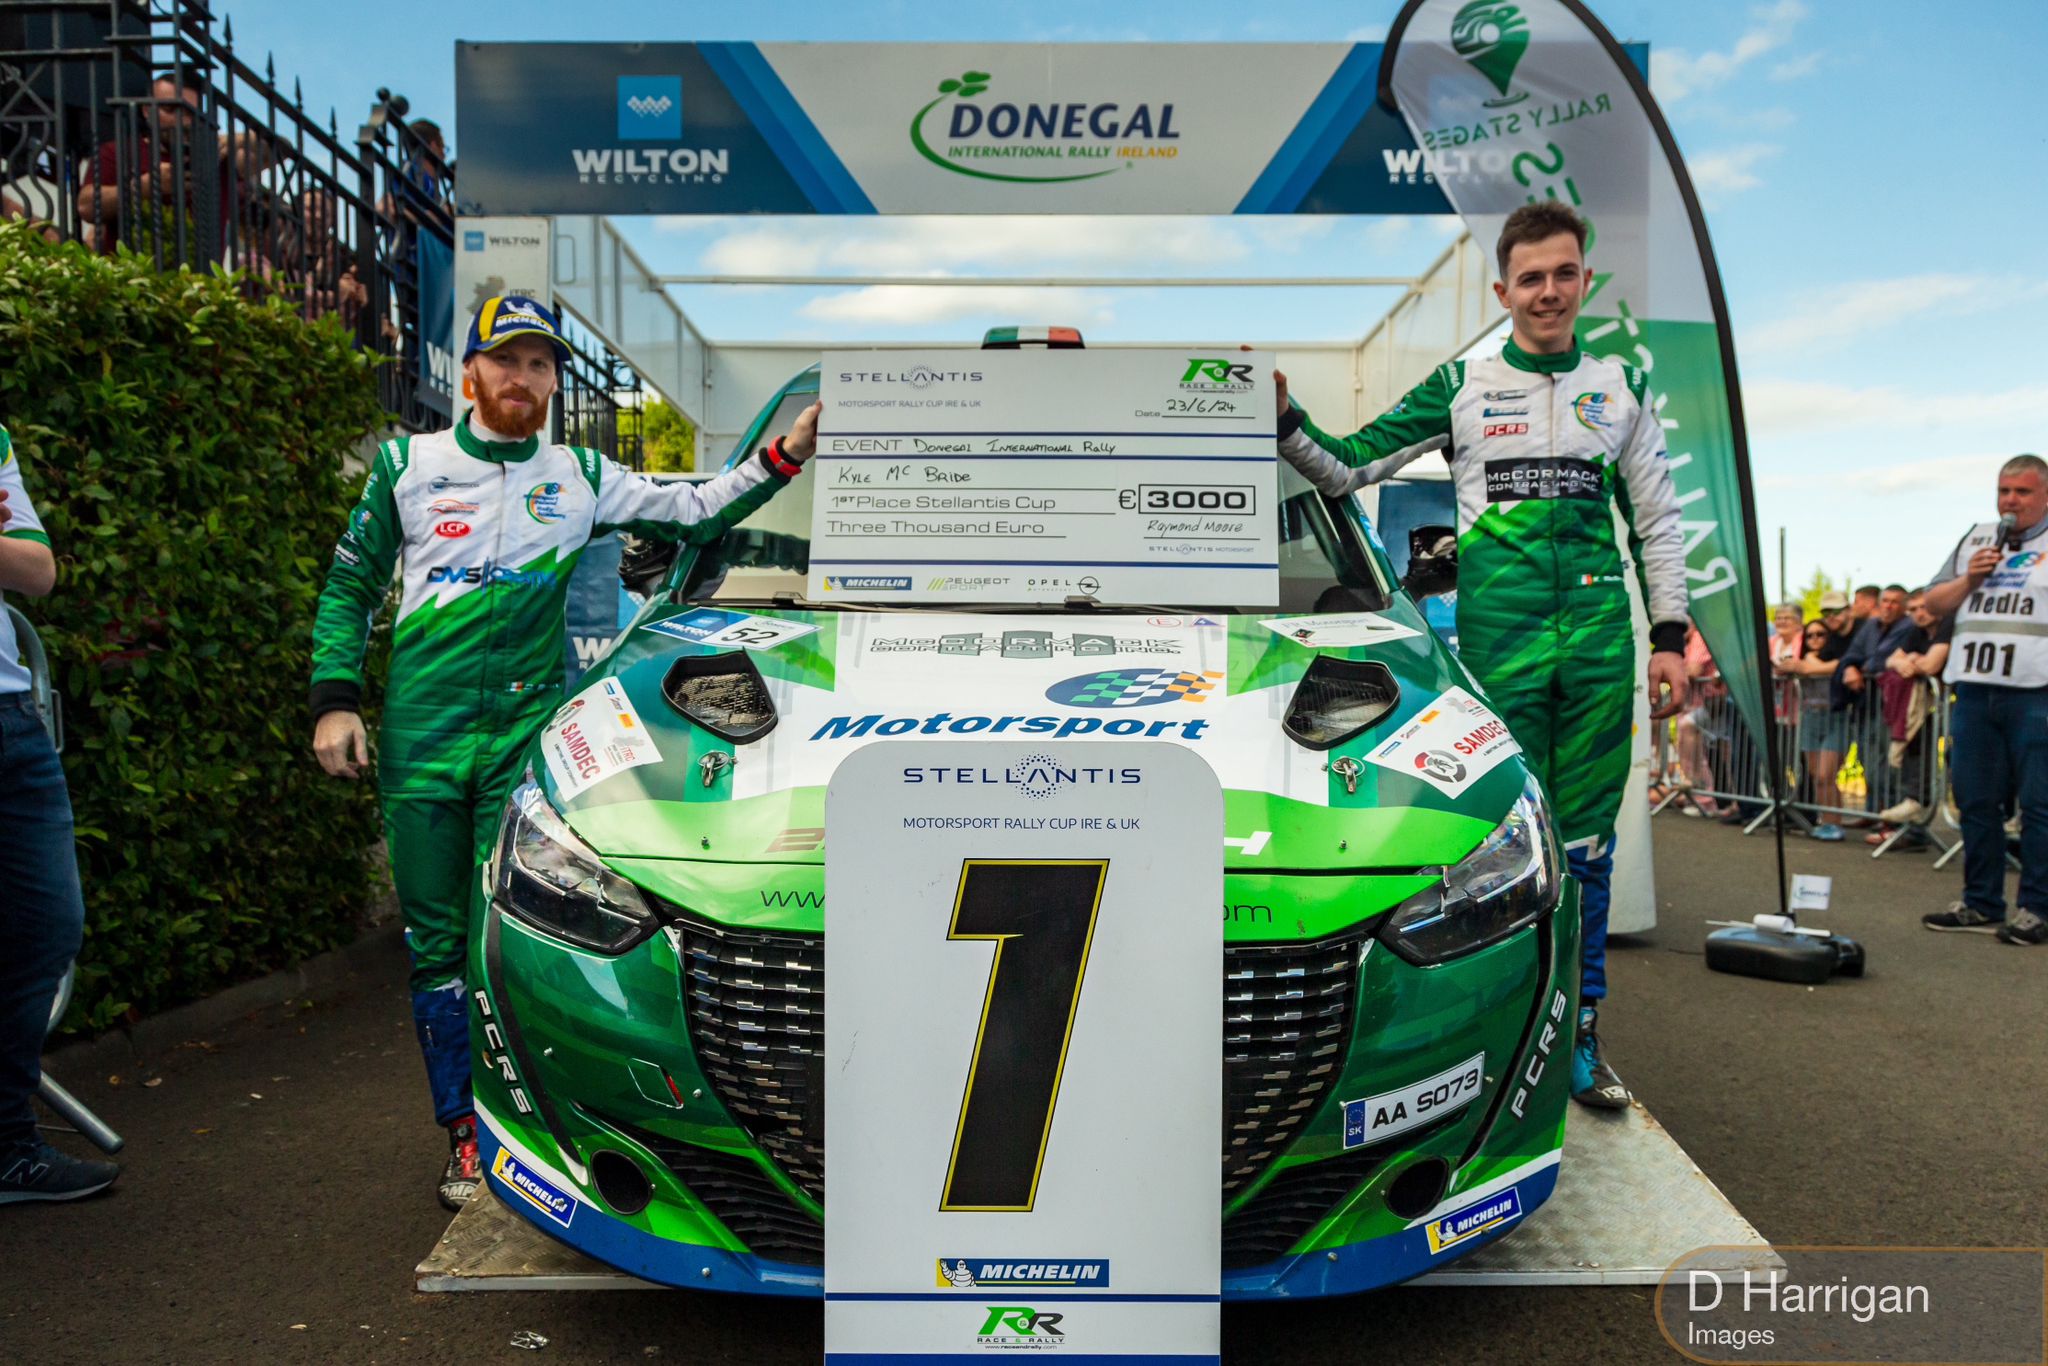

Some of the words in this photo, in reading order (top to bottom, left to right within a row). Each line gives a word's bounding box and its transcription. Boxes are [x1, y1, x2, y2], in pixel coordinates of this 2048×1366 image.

[948, 103, 1181, 139] DONEGAL
[948, 145, 1063, 159] INTERNATIONAL
[1067, 145, 1112, 159] RALLY
[1115, 146, 1179, 159] IRELAND
[572, 148, 729, 174] WILTON
[579, 174, 723, 184] RECYCLING
[488, 236, 541, 247] WILTON
[839, 371, 984, 383] STELLANTIS
[838, 400, 895, 408] MOTORSPORT
[899, 400, 923, 408] RALLY
[926, 400, 942, 408] CUP
[945, 400, 958, 408] IRE
[969, 400, 981, 408] UK
[1166, 397, 1236, 413] 23/6/24
[1485, 424, 1528, 437] PCRS
[832, 439, 903, 452] EVENT
[1083, 441, 1117, 455] Rally
[856, 496, 911, 509] Place
[915, 496, 1011, 509] Stellantis
[1014, 496, 1056, 511] Cup
[1118, 489, 1137, 510] €
[1147, 490, 1247, 510] 3000
[439, 522, 466, 534] LCP
[827, 520, 887, 534] Three
[891, 520, 991, 534] Thousand
[995, 521, 1045, 534] Euro
[845, 578, 908, 588] MICHELIN
[1028, 578, 1071, 586] OPEL
[1968, 592, 2035, 616] Media
[721, 627, 780, 644] 52
[1962, 641, 2017, 677] 101
[809, 711, 1211, 741] Motorsport
[1453, 719, 1509, 756] SAMDEC
[561, 722, 601, 780] SAMDEC
[903, 767, 1142, 784] STELLANTIS
[903, 817, 1000, 830] MOTORSPORT
[1004, 817, 1046, 830] RALLY
[1049, 817, 1076, 830] CUP
[1080, 817, 1103, 830] IRE
[1106, 817, 1117, 830] &
[1120, 817, 1141, 830] UK
[938, 857, 1111, 1213] 1
[473, 988, 535, 1116] PCRS
[1509, 988, 1568, 1120] PCRS
[1348, 1125, 1362, 1136] SK
[1371, 1101, 1408, 1130] AA
[1456, 1198, 1514, 1234] MICHELIN
[978, 1264, 1101, 1280] MICHELIN
